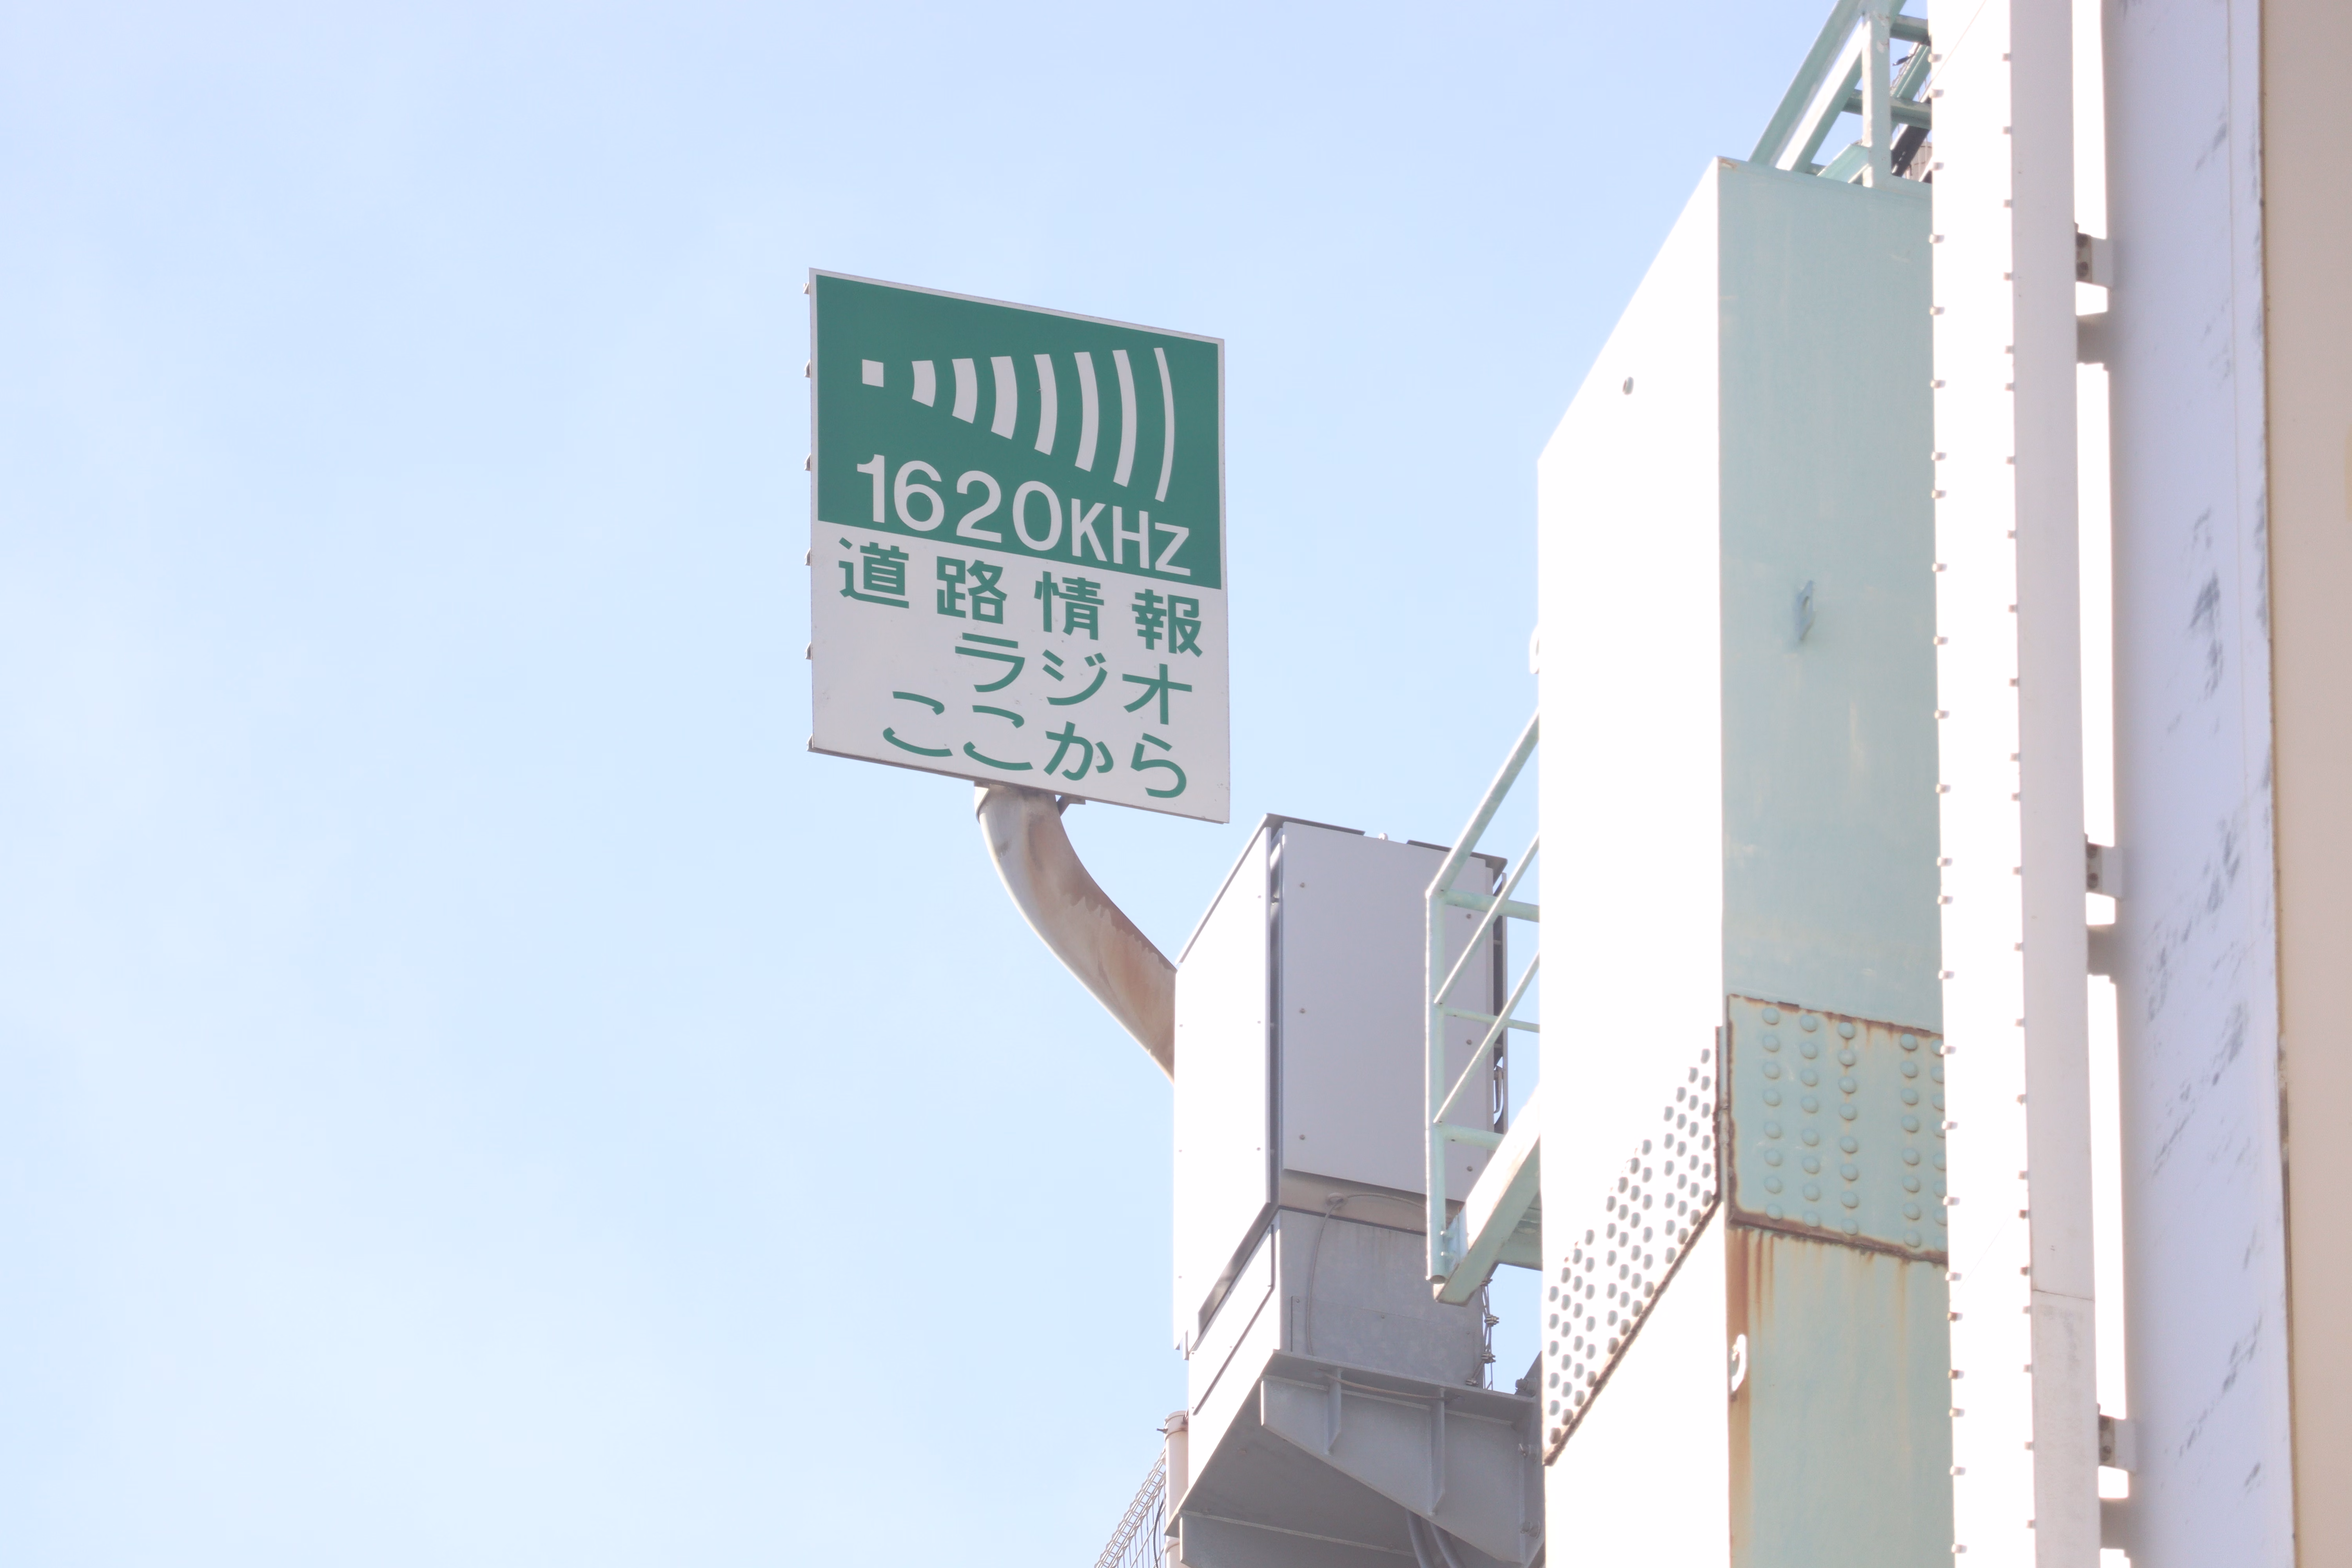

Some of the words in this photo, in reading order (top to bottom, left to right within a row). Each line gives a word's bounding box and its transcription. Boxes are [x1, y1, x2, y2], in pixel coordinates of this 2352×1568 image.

[838, 537, 1203, 657] 道路情報
[955, 632, 1192, 725] ラジオ
[882, 690, 1187, 799] ここから
